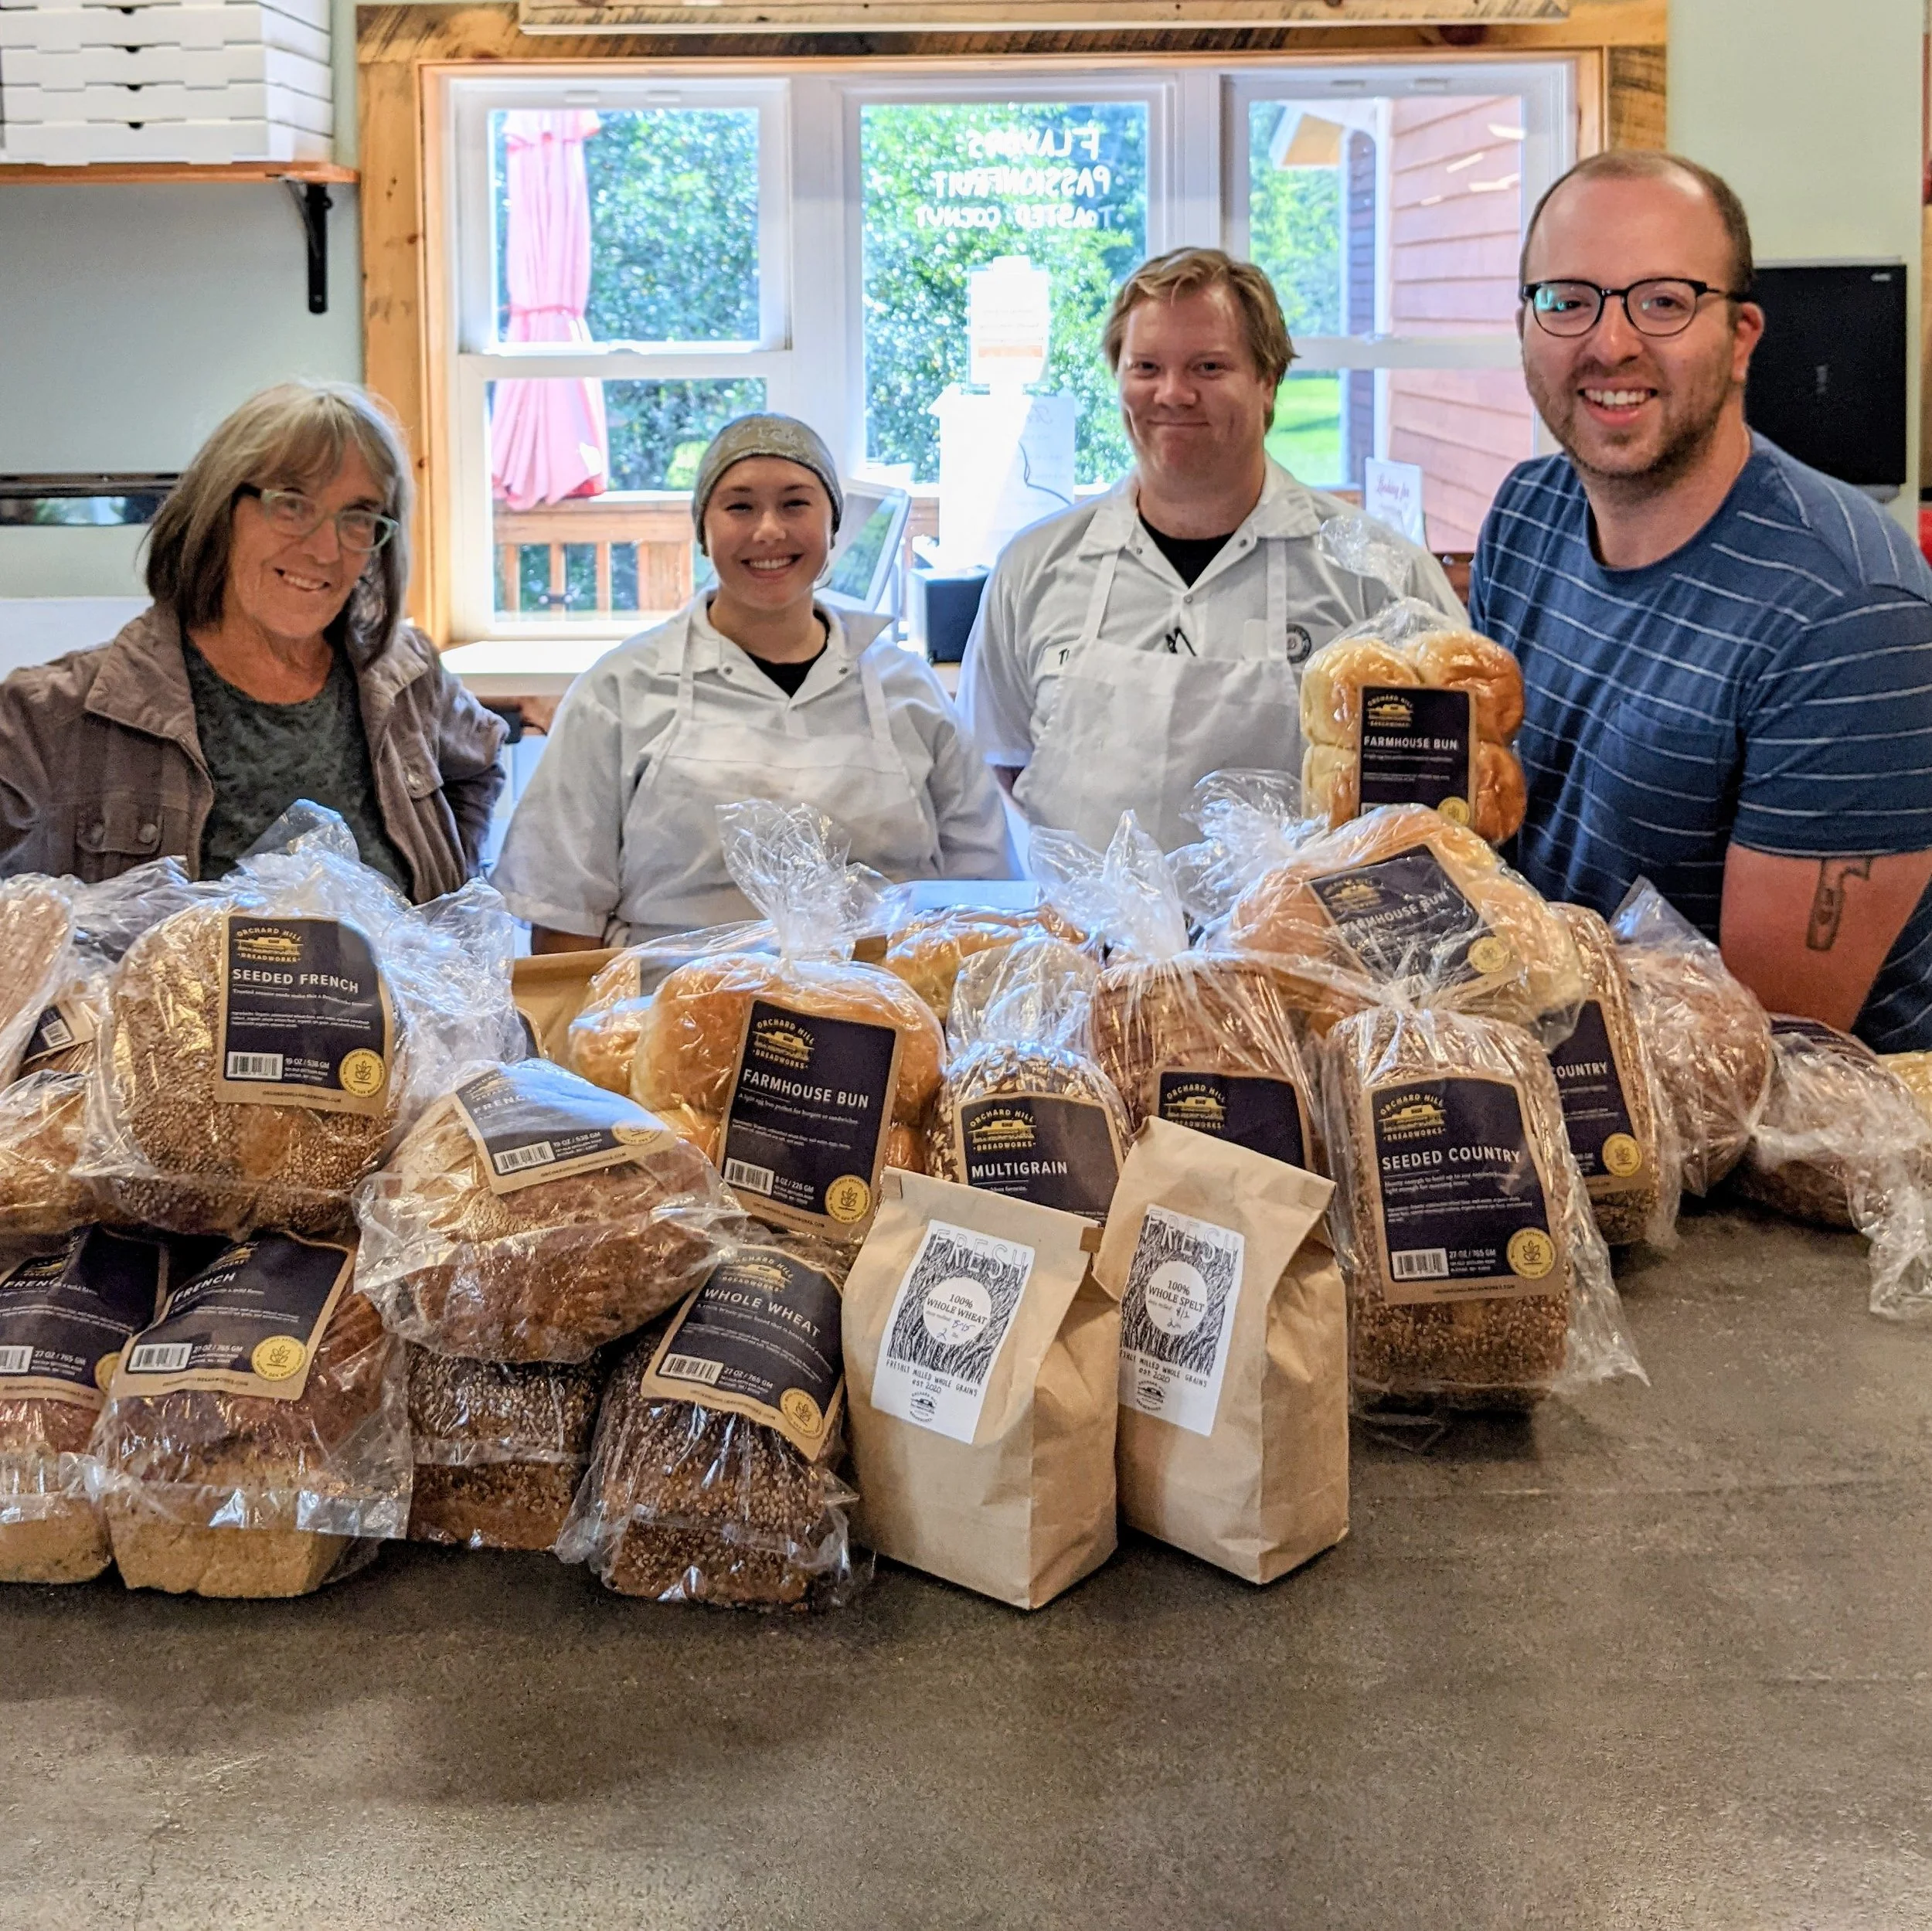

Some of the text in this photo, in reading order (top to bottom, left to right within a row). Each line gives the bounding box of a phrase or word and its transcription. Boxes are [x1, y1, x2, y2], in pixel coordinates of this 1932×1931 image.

[1363, 735, 1458, 750] FARMHOUSE BUN
[236, 927, 302, 941] ORCHARD HILL
[232, 968, 359, 994] SEEDED FRENCH
[757, 1019, 815, 1045] ORCHARD HILL
[1553, 1061, 1607, 1079] OUNTRY
[743, 1069, 869, 1109] FARMHOUSE BUN
[1167, 1083, 1206, 1100] ORCHARD
[1380, 1093, 1443, 1115] ORCHARD HILL
[970, 1109, 1034, 1127] ORCHARD HILL
[976, 1141, 1032, 1151] BREADWORKS
[971, 1161, 1068, 1178] MULTIGRAIN
[1382, 1146, 1520, 1171] SEEDED COUNTRY
[1145, 1209, 1239, 1268] FRESH
[730, 1256, 774, 1265] CHARD
[930, 1229, 1027, 1283] FRESH
[3, 1277, 62, 1288] FRENC
[174, 1273, 236, 1303] FRENCH
[1168, 1280, 1190, 1295] 100%
[949, 1294, 973, 1309] 100%
[1149, 1285, 1205, 1312] WHOLE SPELT
[705, 1287, 763, 1308] WHOLE
[767, 1301, 821, 1338] WHEAT
[927, 1298, 988, 1324] WHOLE WHEAT
[912, 1368, 932, 1380] MILLED
[934, 1376, 952, 1388] WHOLE
[955, 1383, 978, 1397] GRAINS
[1139, 1358, 1159, 1370] MILLED
[1162, 1366, 1181, 1378] WHOLE
[1185, 1374, 1207, 1388] GRAINS
[926, 1382, 941, 1393] 2020
